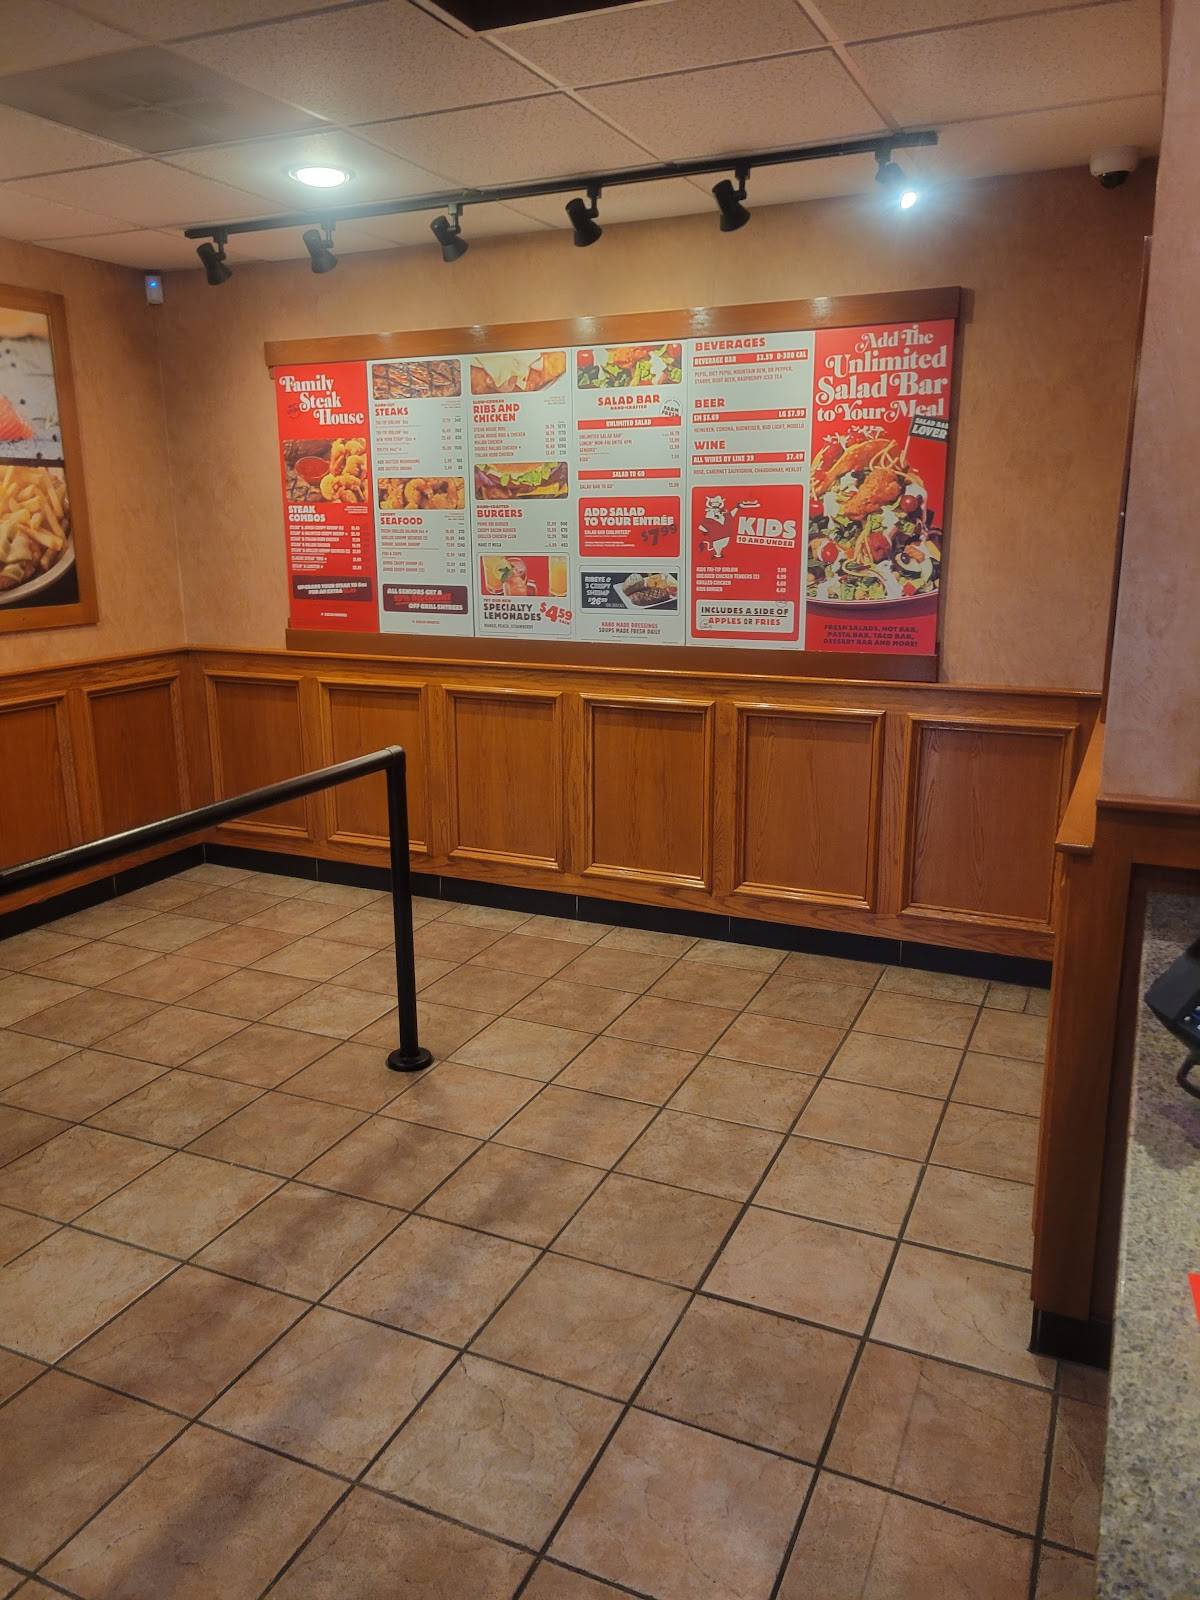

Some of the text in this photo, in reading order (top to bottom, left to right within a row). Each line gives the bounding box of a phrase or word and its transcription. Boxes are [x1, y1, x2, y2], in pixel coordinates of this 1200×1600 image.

[854, 324, 934, 353] Add The
[695, 337, 766, 351] BEVERAGES
[694, 356, 723, 365] BEVERAGE
[825, 345, 947, 378] Unlimited
[279, 375, 334, 392] Family
[815, 371, 948, 406] Salad Bar
[299, 391, 342, 412] Steak
[598, 394, 660, 406] SALAD BAR
[694, 399, 725, 408] BEER
[375, 408, 408, 416] STEAKS
[474, 404, 519, 414] RIBS AND
[778, 410, 787, 418] LG
[816, 398, 944, 423] to Your Meal
[313, 409, 364, 425] House
[474, 413, 515, 423] CHICKEN
[911, 424, 948, 439] LOVER
[694, 440, 726, 450] WINE
[288, 505, 316, 513] STEAK
[584, 507, 645, 516] ADD SALAD
[289, 514, 325, 522] COMBOS
[380, 517, 422, 525] SEAFOOD
[584, 517, 598, 526] TO
[600, 517, 631, 526] YOUR
[738, 516, 796, 539] KIDS
[701, 606, 743, 614] INCLUDES
[484, 612, 541, 621] LEMONADES
[708, 617, 741, 625] APPLES
